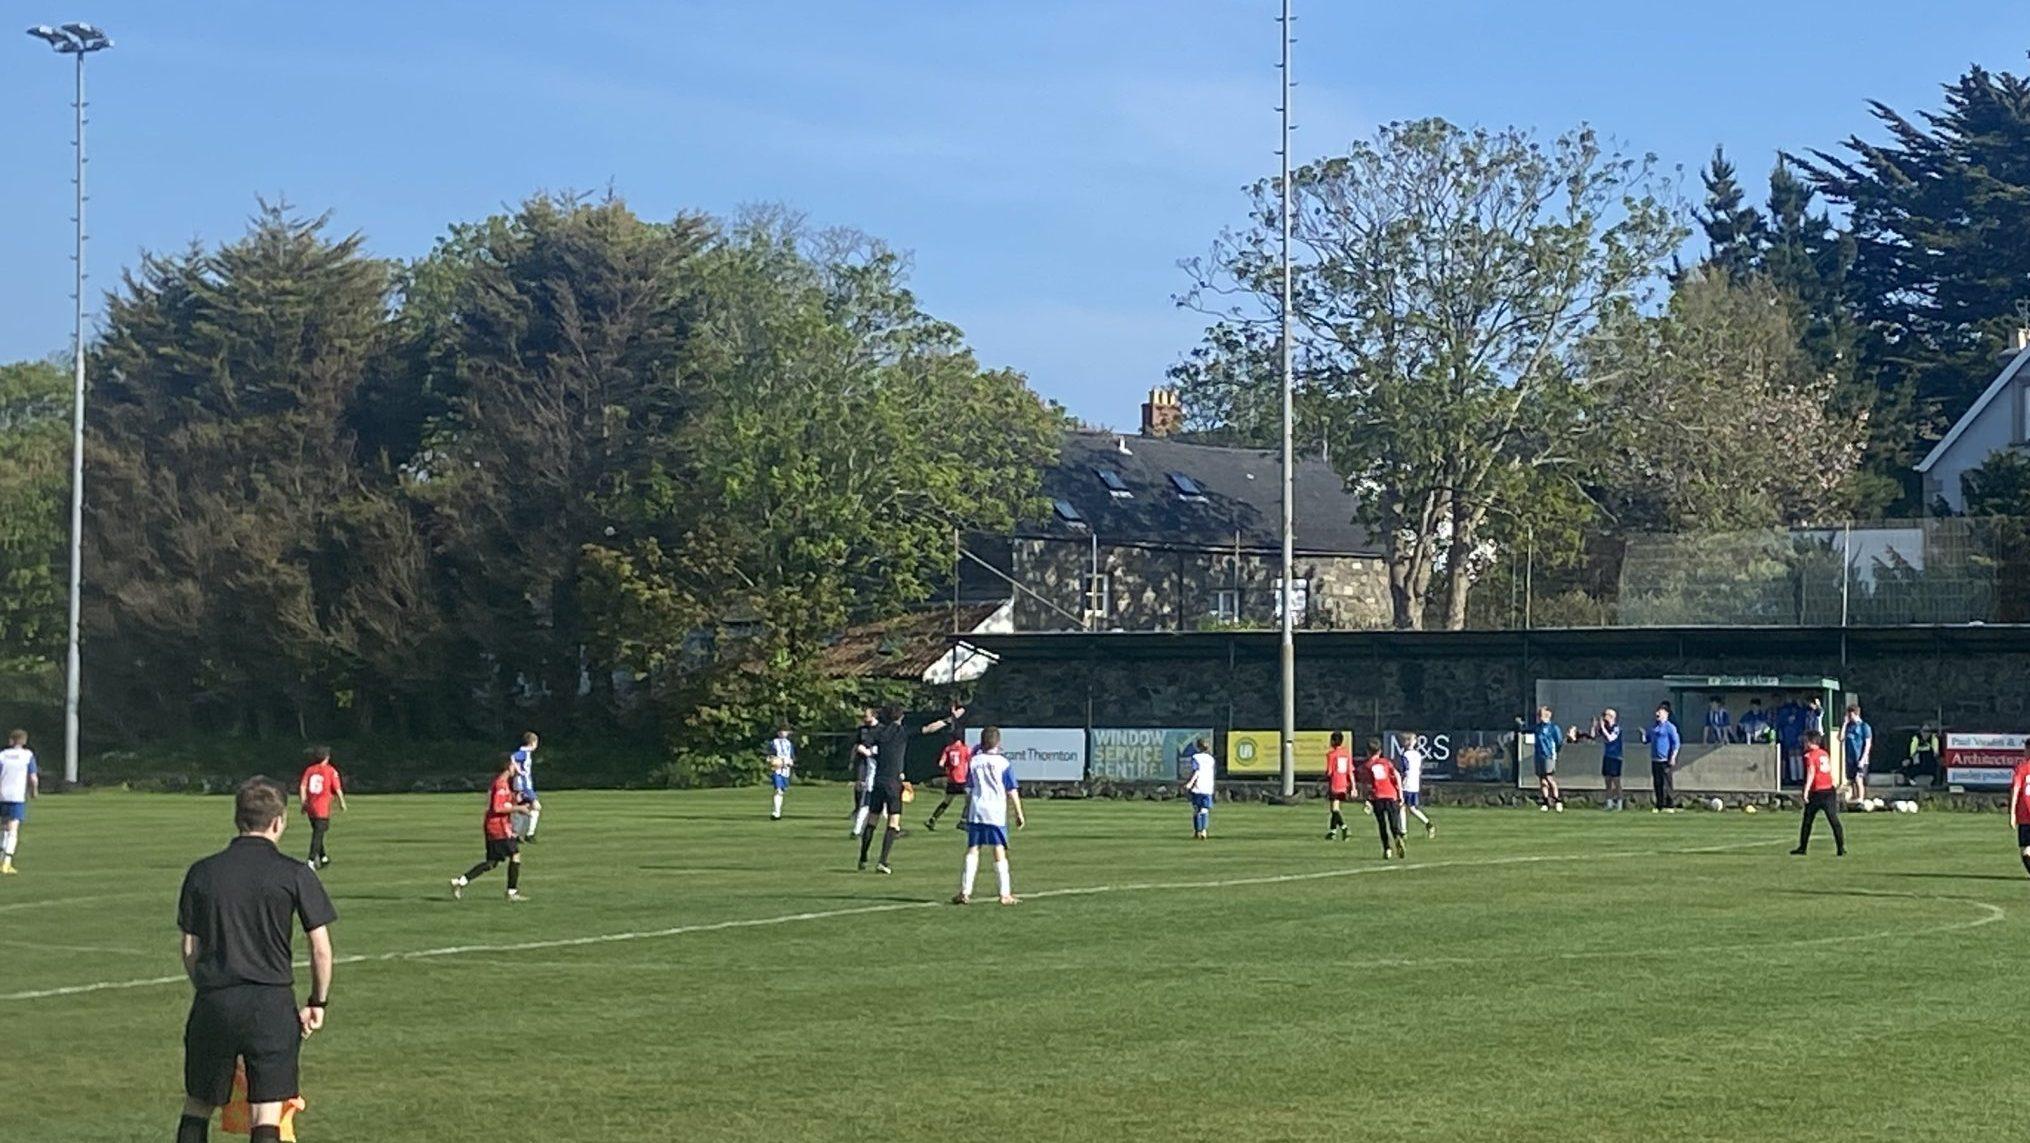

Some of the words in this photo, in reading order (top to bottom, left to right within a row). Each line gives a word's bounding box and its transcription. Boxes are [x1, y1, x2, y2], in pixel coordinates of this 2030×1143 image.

[1095, 730, 1166, 745] WINDOW
[1028, 748, 1078, 761] Thornton
[1094, 746, 1163, 762] SERVICE
[1391, 734, 1450, 760] M&S
[309, 773, 324, 794] 6
